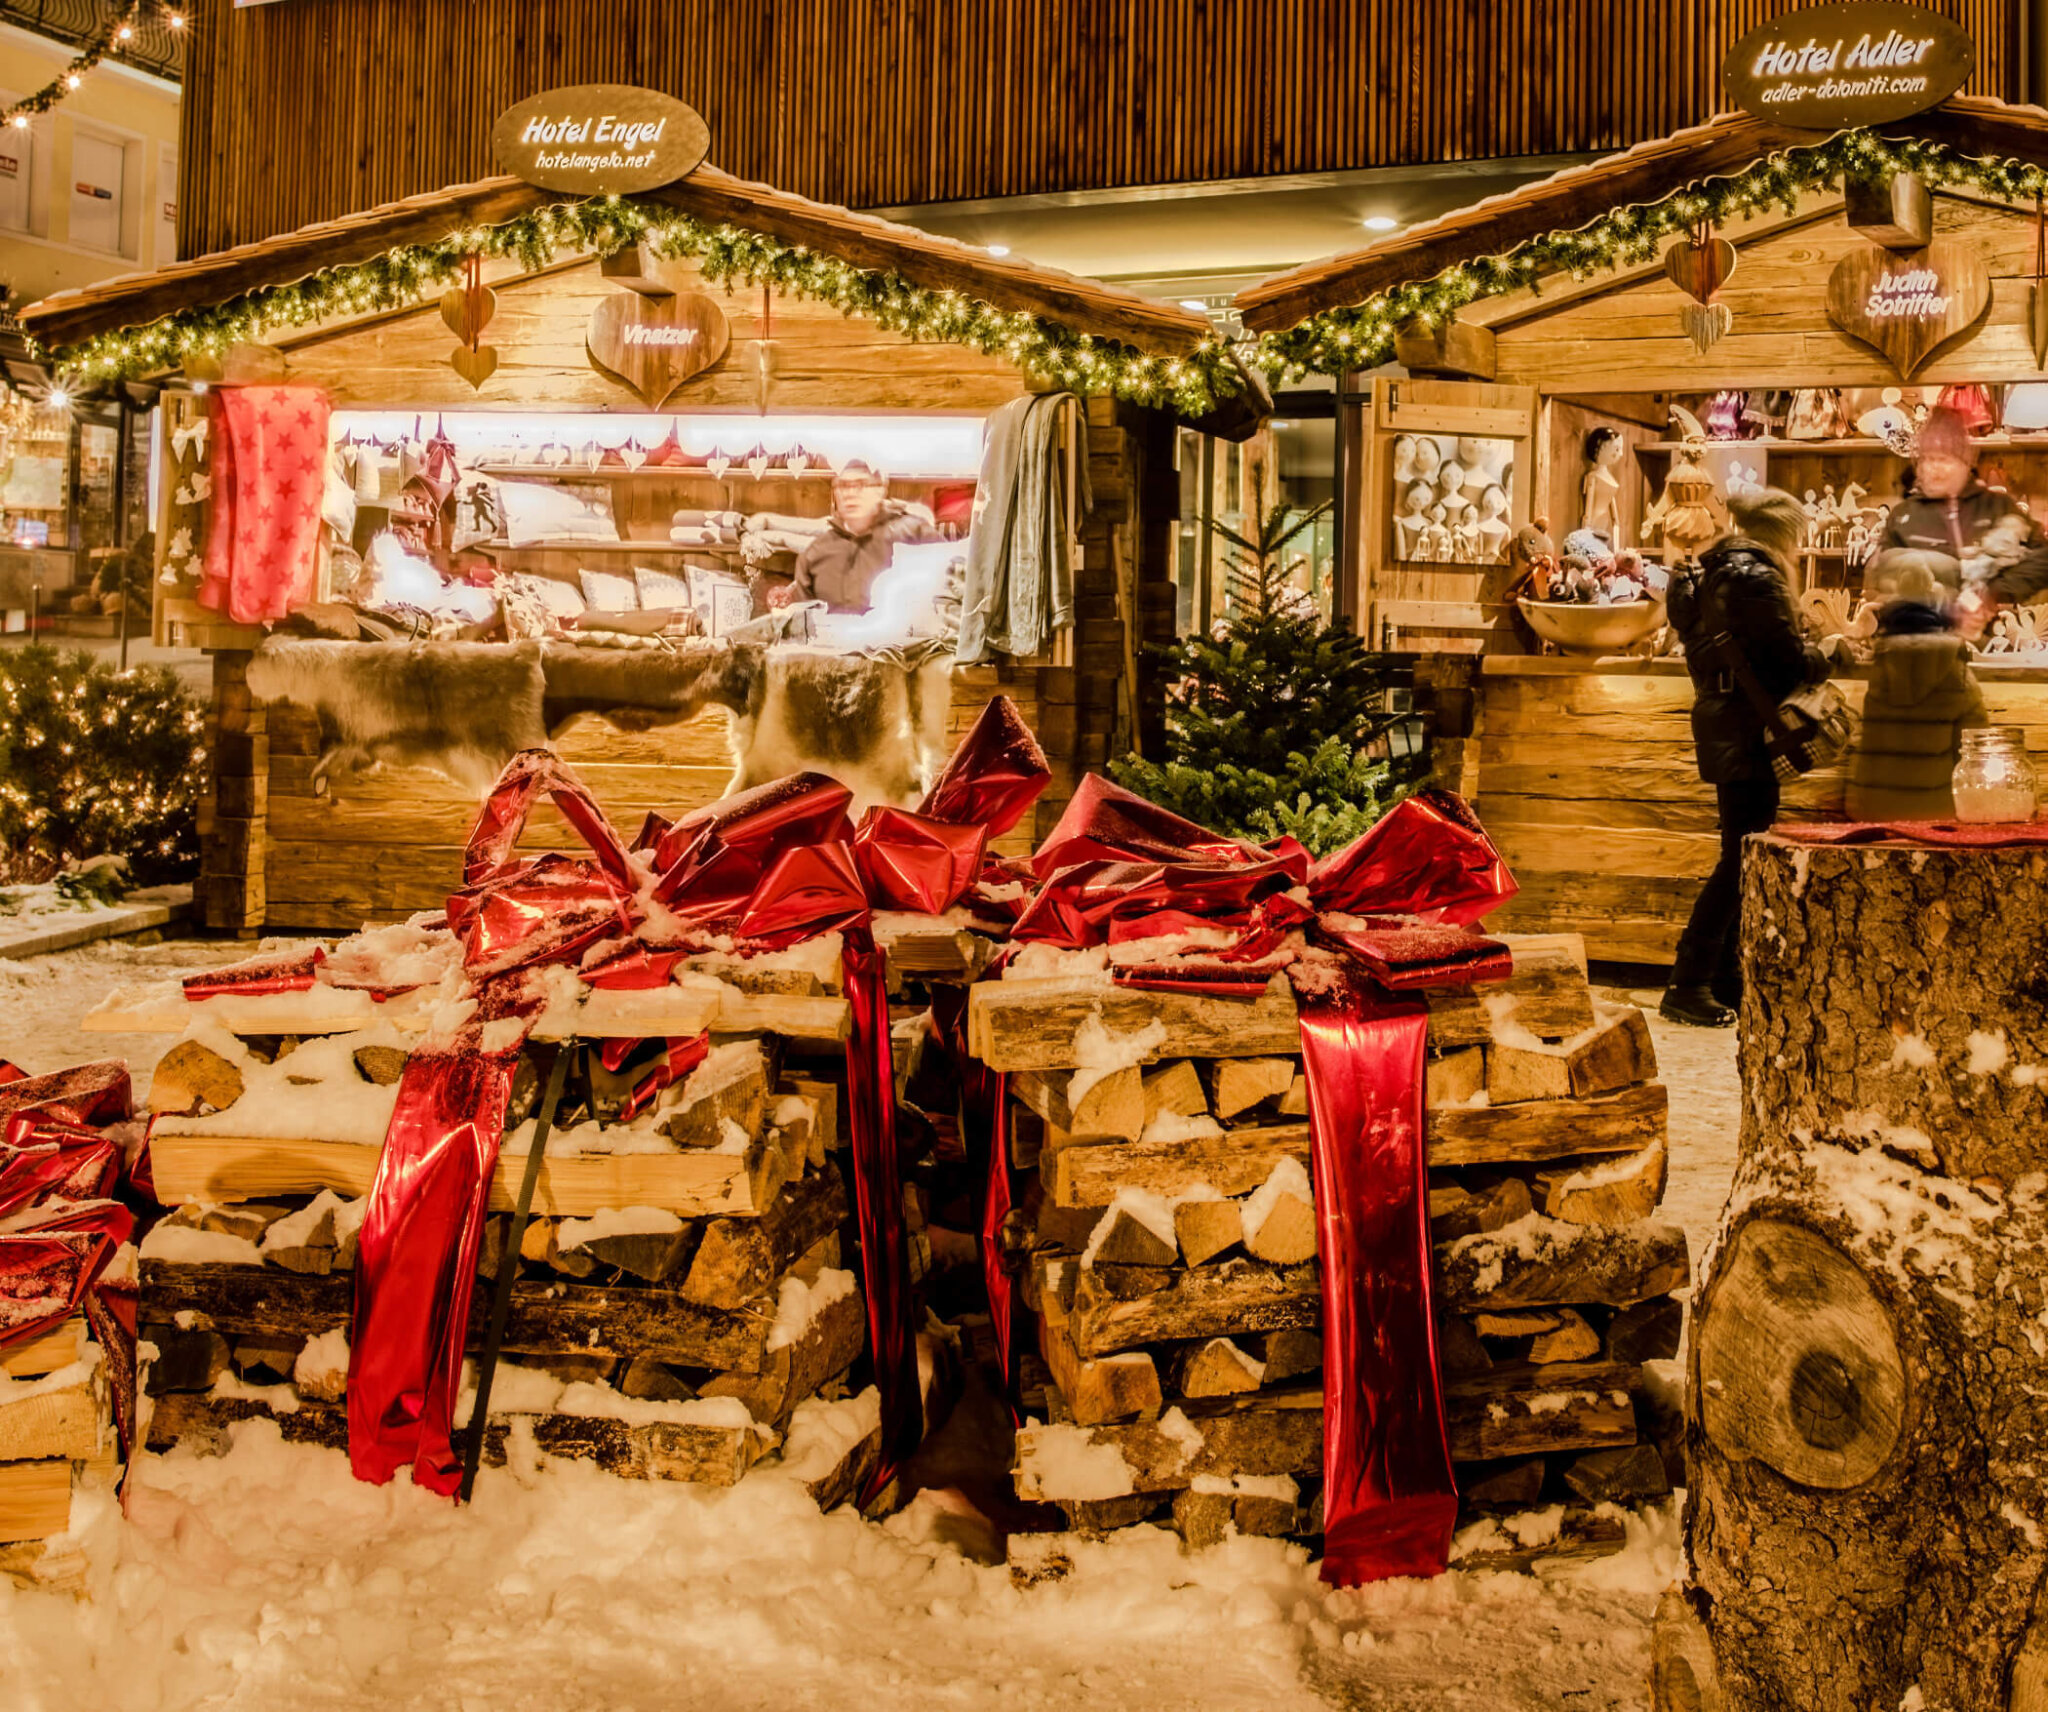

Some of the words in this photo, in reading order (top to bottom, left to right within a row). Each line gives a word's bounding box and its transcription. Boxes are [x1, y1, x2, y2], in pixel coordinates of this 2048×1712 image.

[1752, 38, 1843, 77] Hotel
[1844, 29, 1935, 69] Adler
[1761, 75, 1927, 103] adler-dolomiti.com
[521, 115, 593, 144] Hotel
[593, 115, 666, 151] Engel
[535, 149, 656, 173] hotelangelo.net
[1871, 269, 1938, 293] Judith
[1864, 293, 1953, 318] Sotriffer
